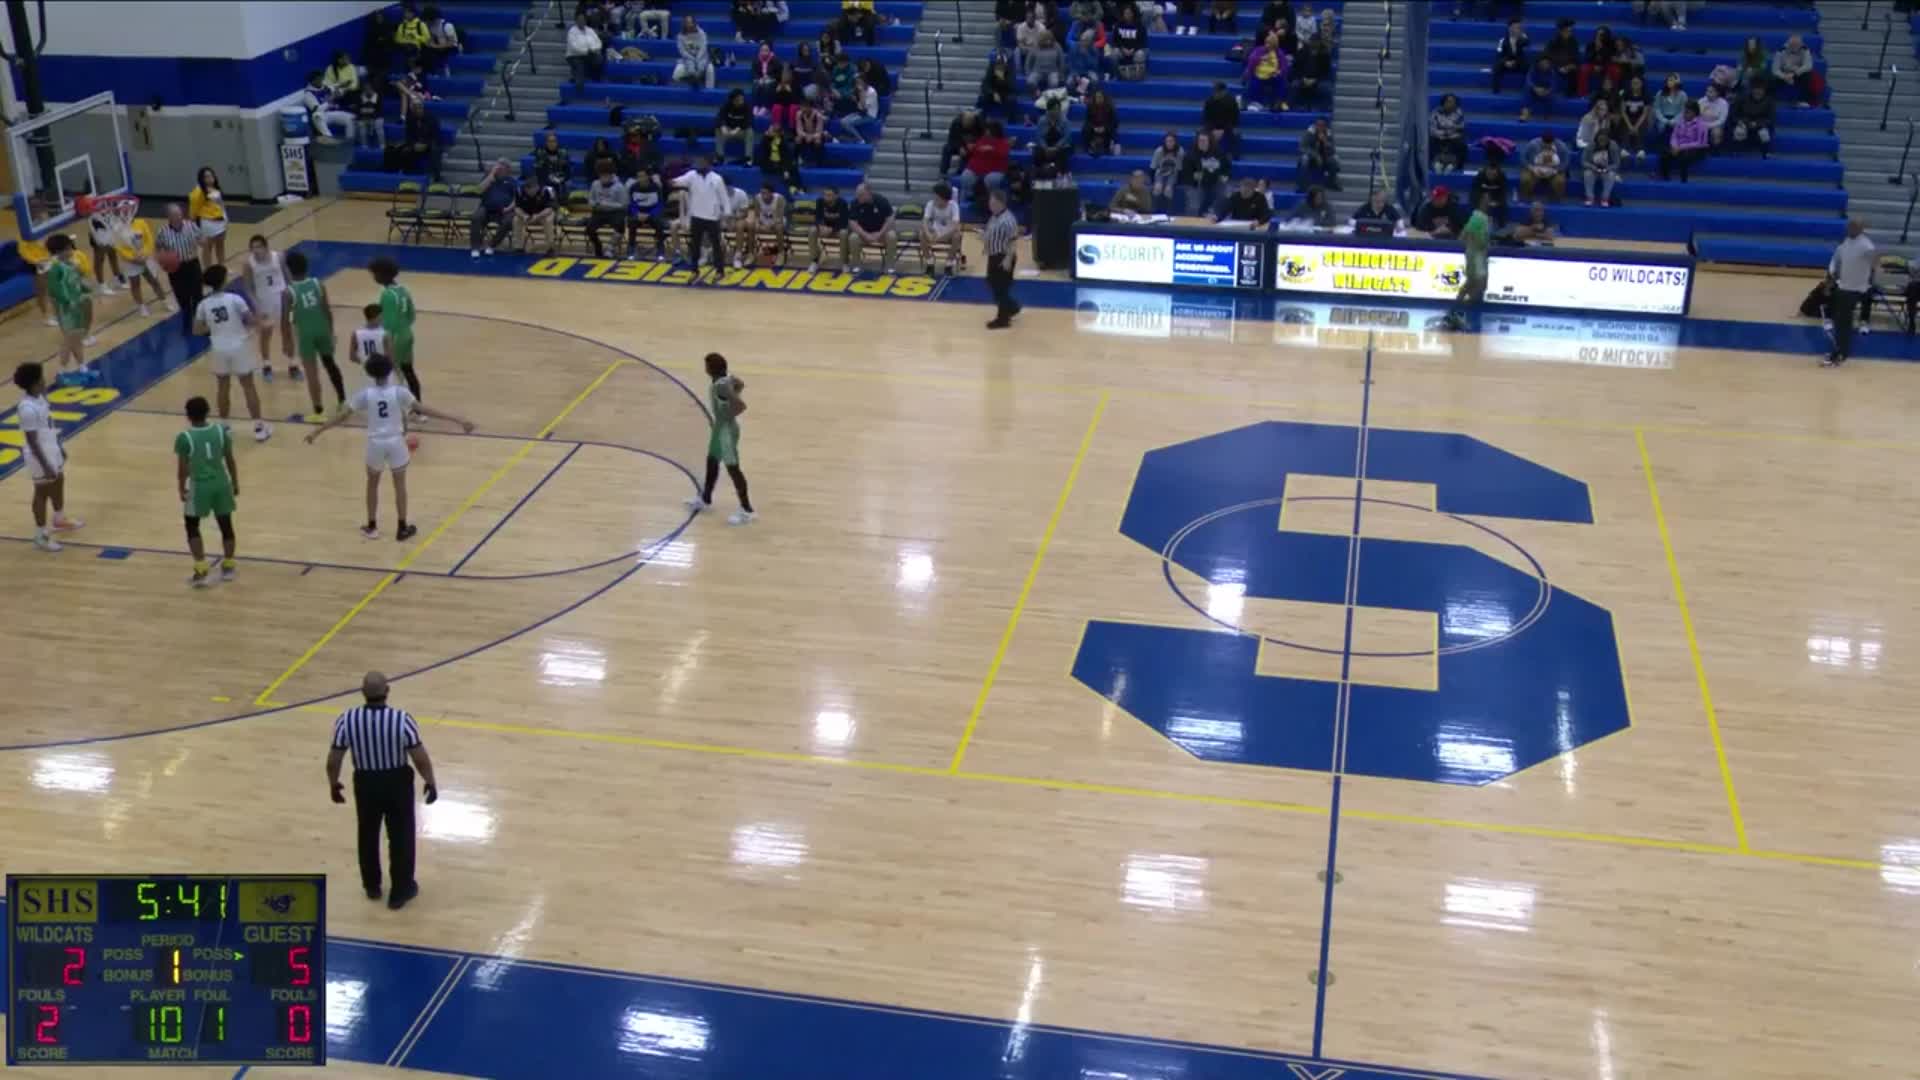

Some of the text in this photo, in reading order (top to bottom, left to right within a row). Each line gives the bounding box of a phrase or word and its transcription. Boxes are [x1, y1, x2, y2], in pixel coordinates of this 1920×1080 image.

[283, 147, 304, 160] SHS
[1103, 244, 1165, 263] SECURITY
[1589, 266, 1687, 287] GO WILDCATS!
[301, 291, 317, 309] 15
[211, 306, 229, 323] 30
[364, 339, 376, 355] 10
[378, 401, 389, 418] 2
[205, 442, 212, 460] 1
